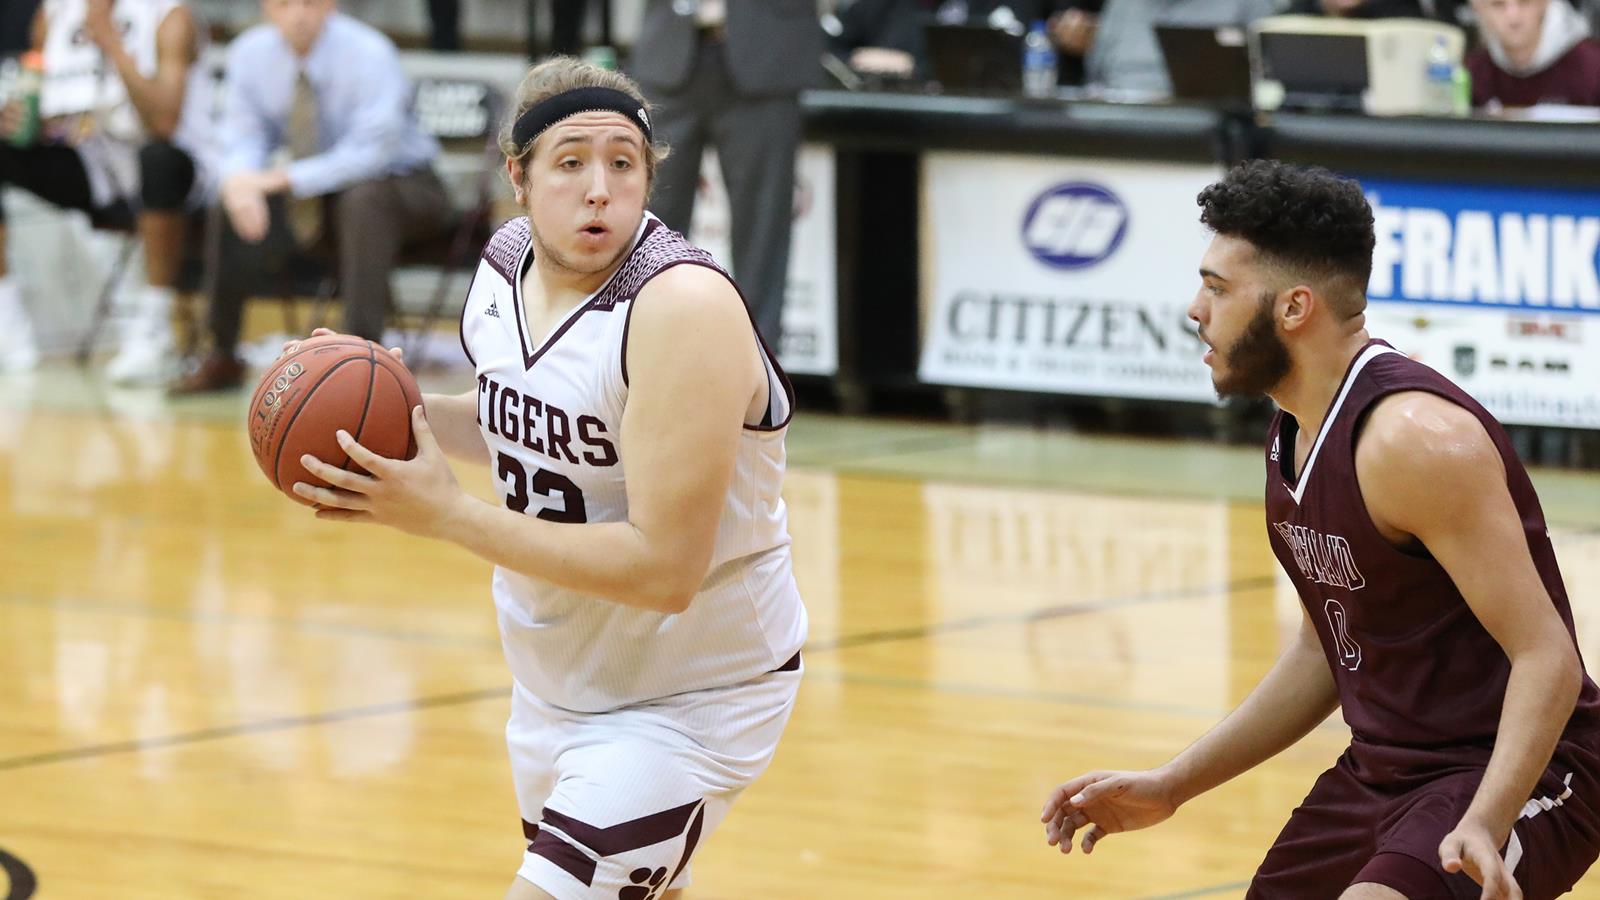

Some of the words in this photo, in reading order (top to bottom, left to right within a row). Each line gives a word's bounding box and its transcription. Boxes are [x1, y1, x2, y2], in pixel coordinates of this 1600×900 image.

[1370, 204, 1600, 308] FRANK
[477, 373, 619, 467] TIGERS
[498, 450, 588, 524] 32
[1324, 598, 1362, 671] 0
